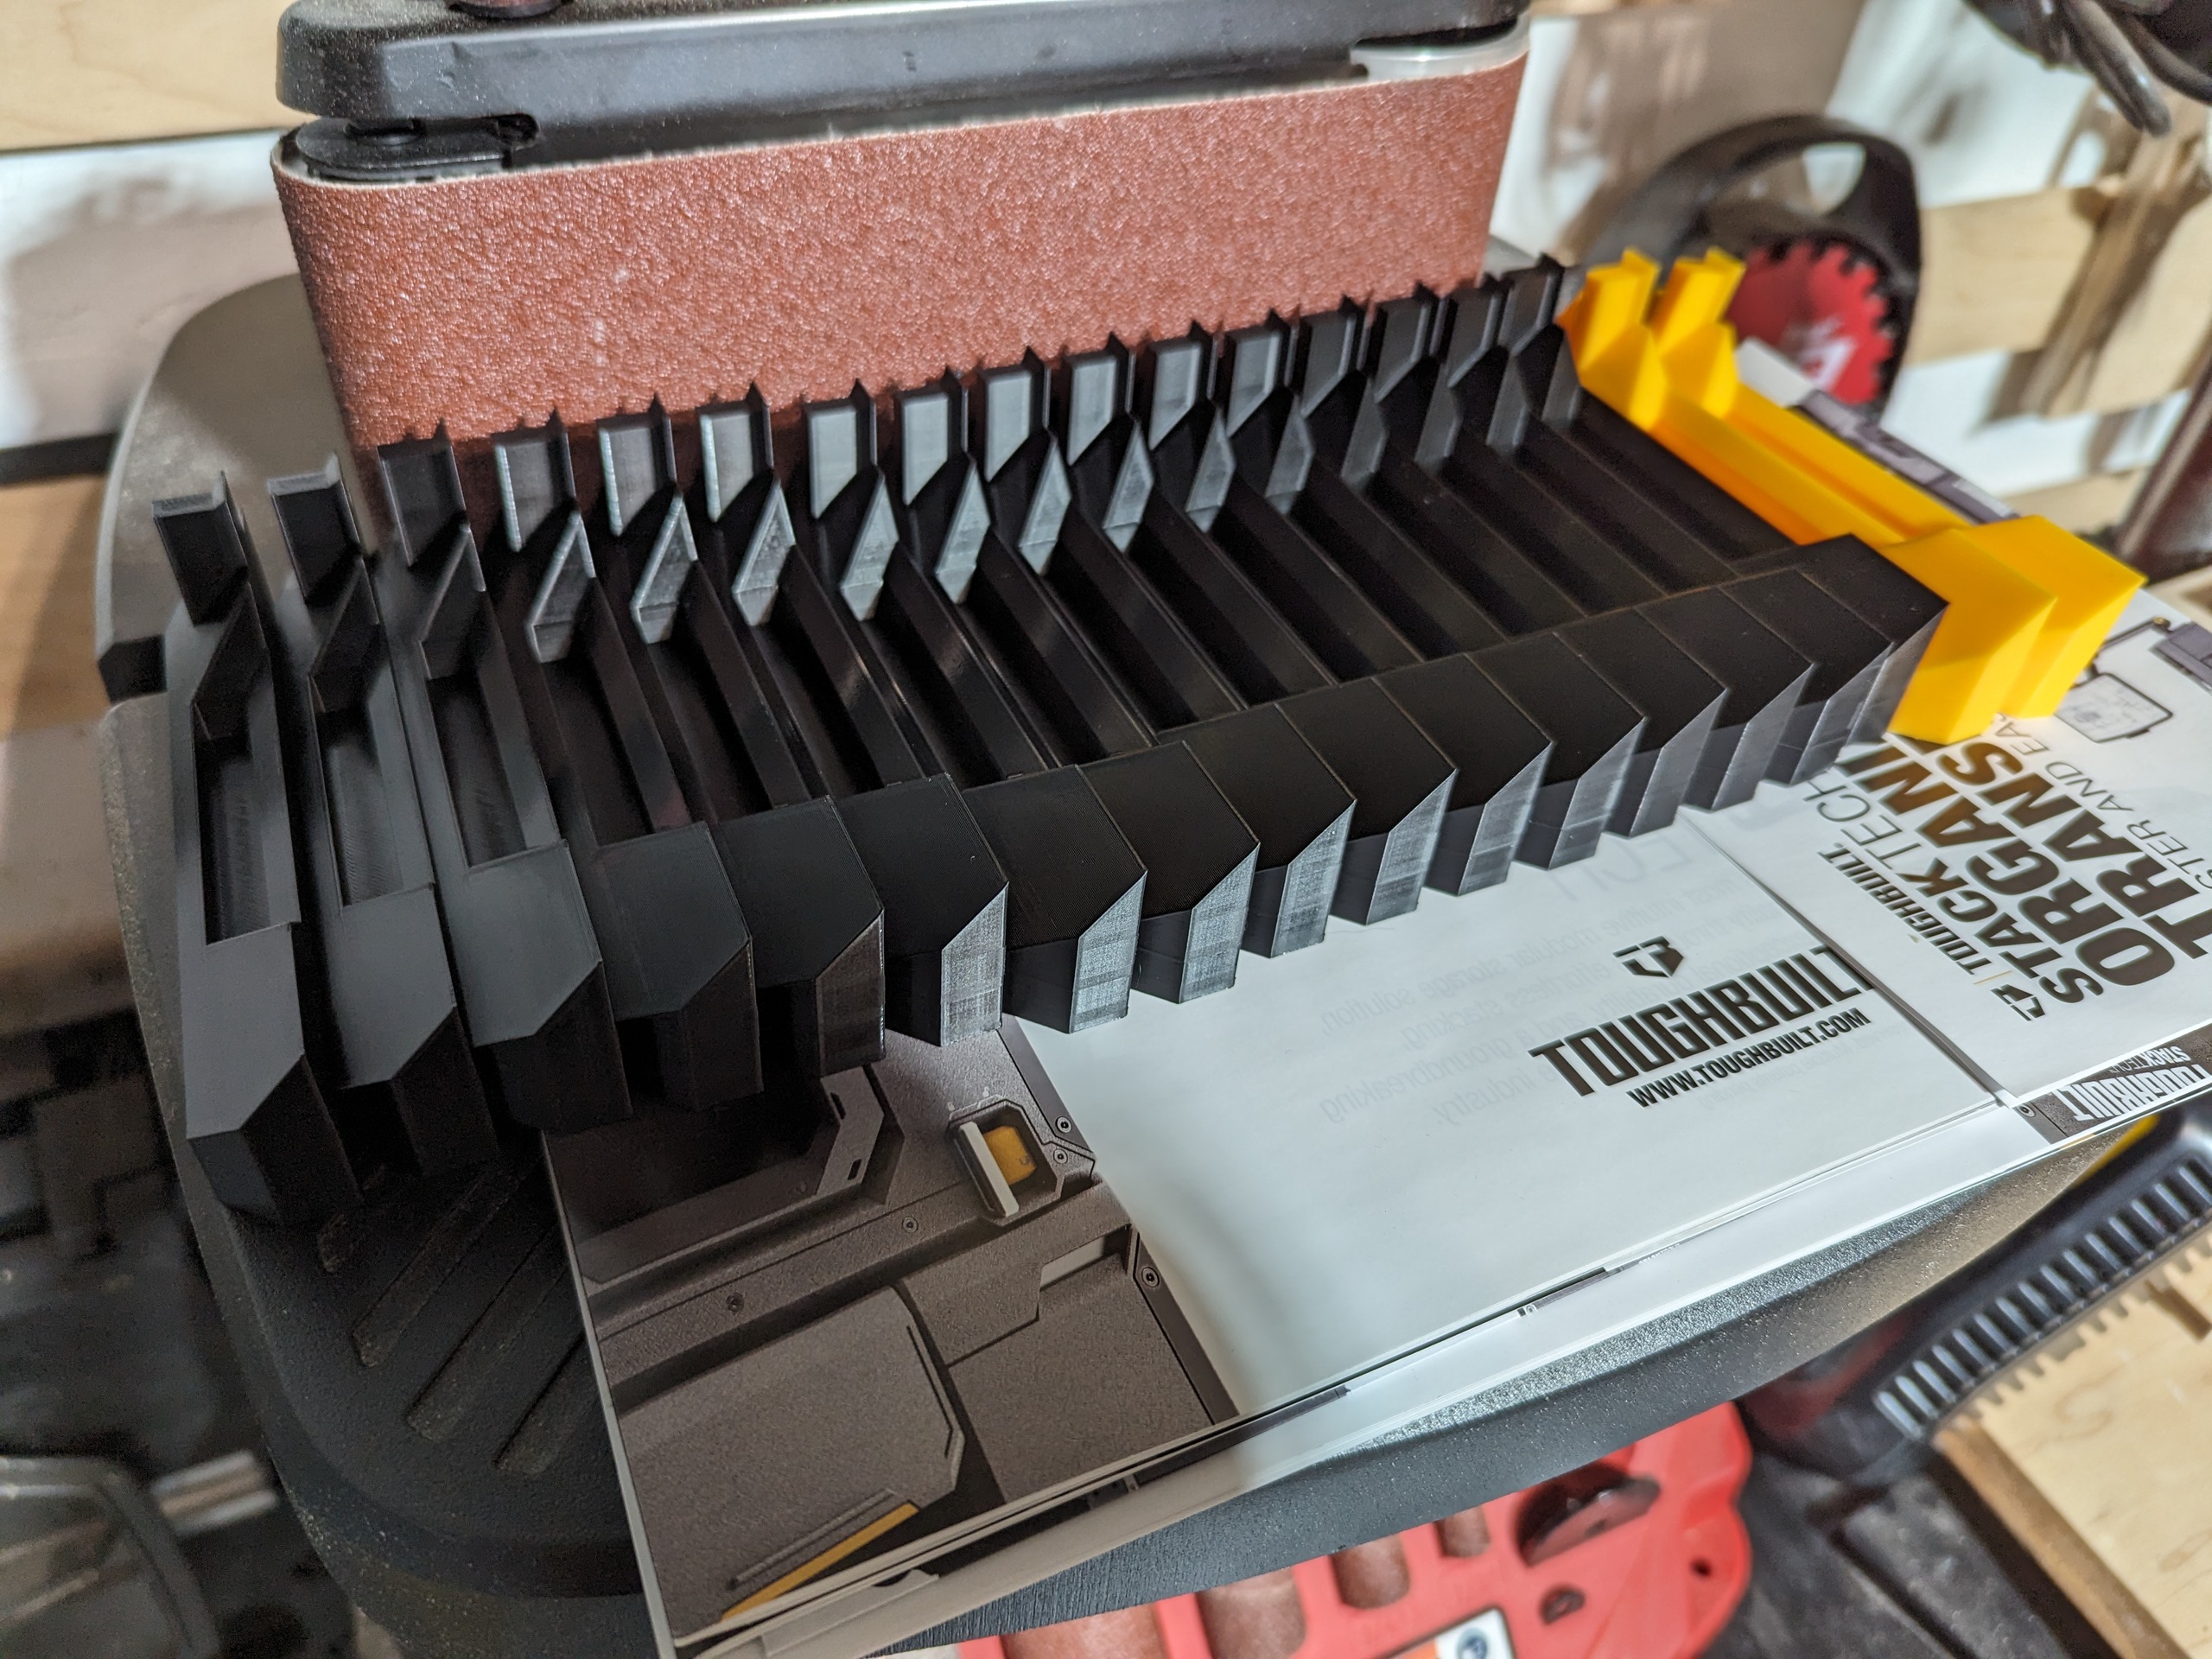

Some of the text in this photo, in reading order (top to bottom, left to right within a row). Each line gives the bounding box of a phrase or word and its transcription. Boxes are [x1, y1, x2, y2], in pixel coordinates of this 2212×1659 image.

[1993, 711, 2050, 757] EA
[2045, 760, 2135, 813] AND
[1897, 734, 2212, 960] TRANS
[1817, 847, 1993, 976] TOUGHBUILT
[1528, 944, 1876, 1097] TOUGHBUILT
[1625, 1007, 1872, 1109] WWW.TOUGHBUILT.COM
